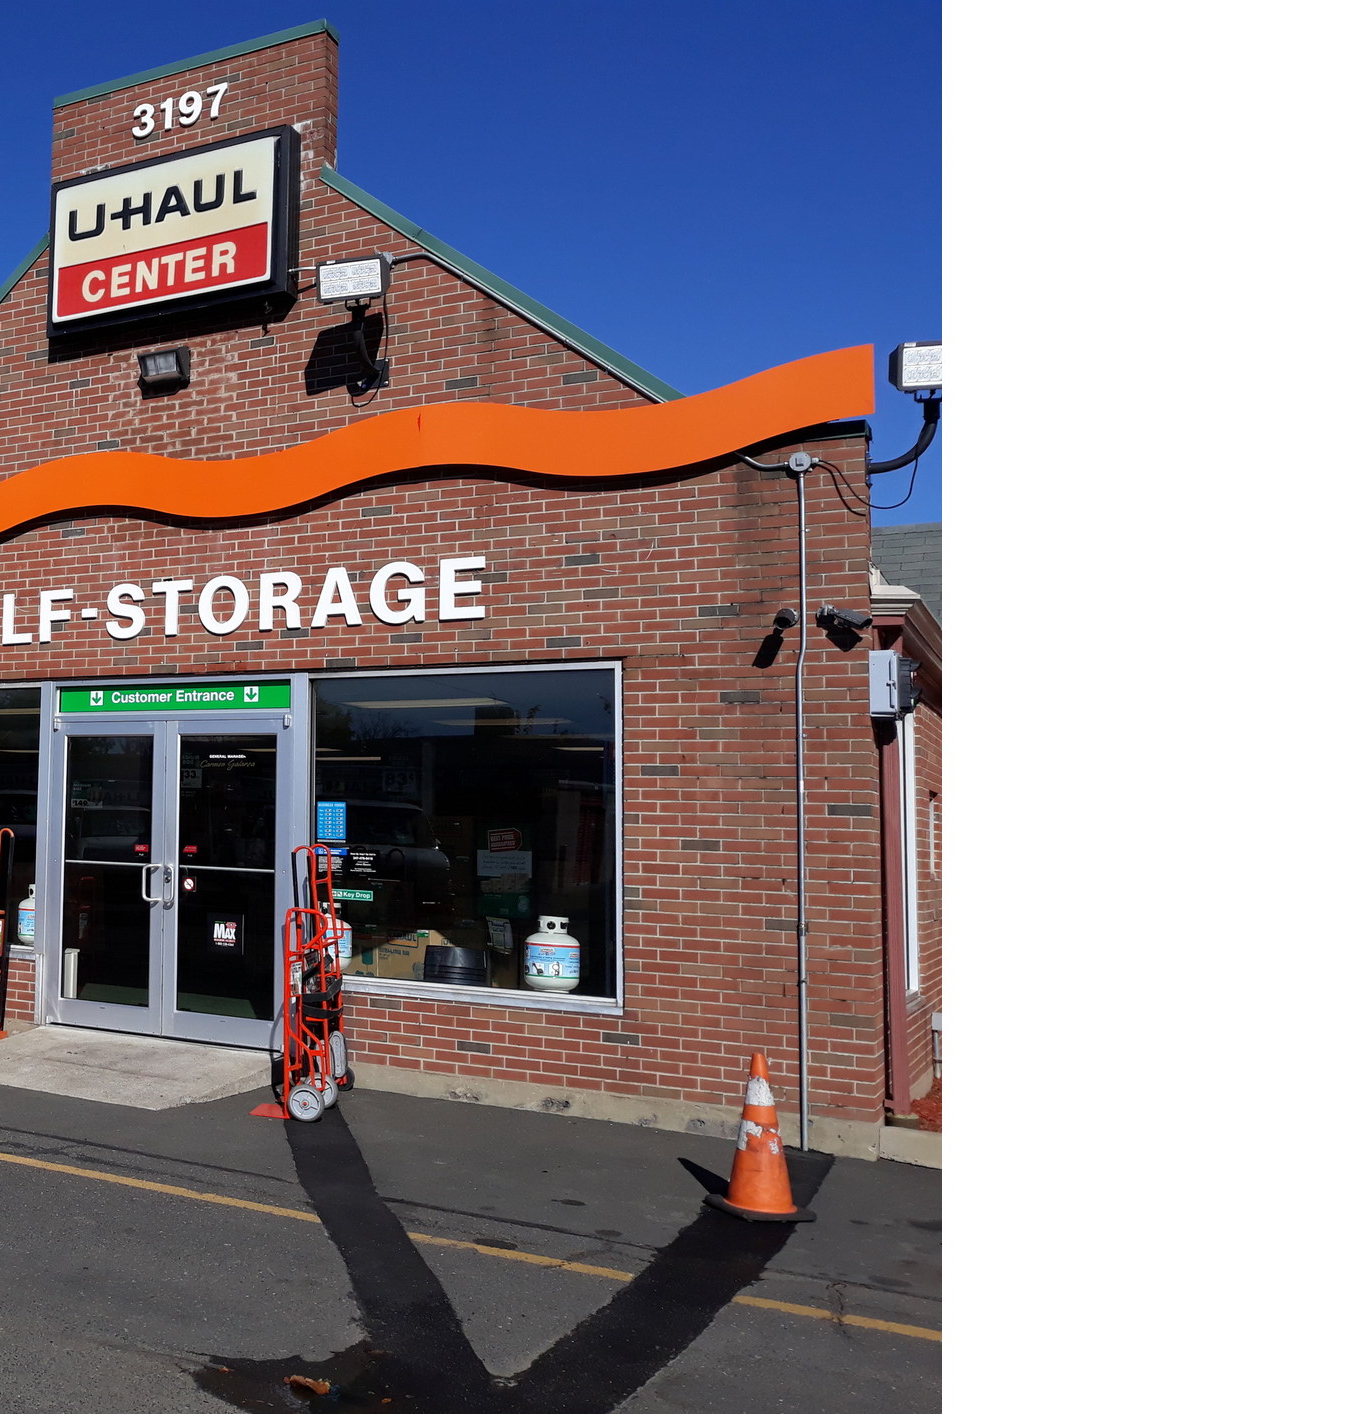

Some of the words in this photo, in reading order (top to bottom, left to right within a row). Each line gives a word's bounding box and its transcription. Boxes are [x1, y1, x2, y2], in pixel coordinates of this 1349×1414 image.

[131, 82, 228, 139] 3197
[68, 168, 257, 242] U-HAUL
[82, 241, 237, 303] CENTER
[111, 691, 173, 705] Customer
[176, 689, 235, 703] Entrance
